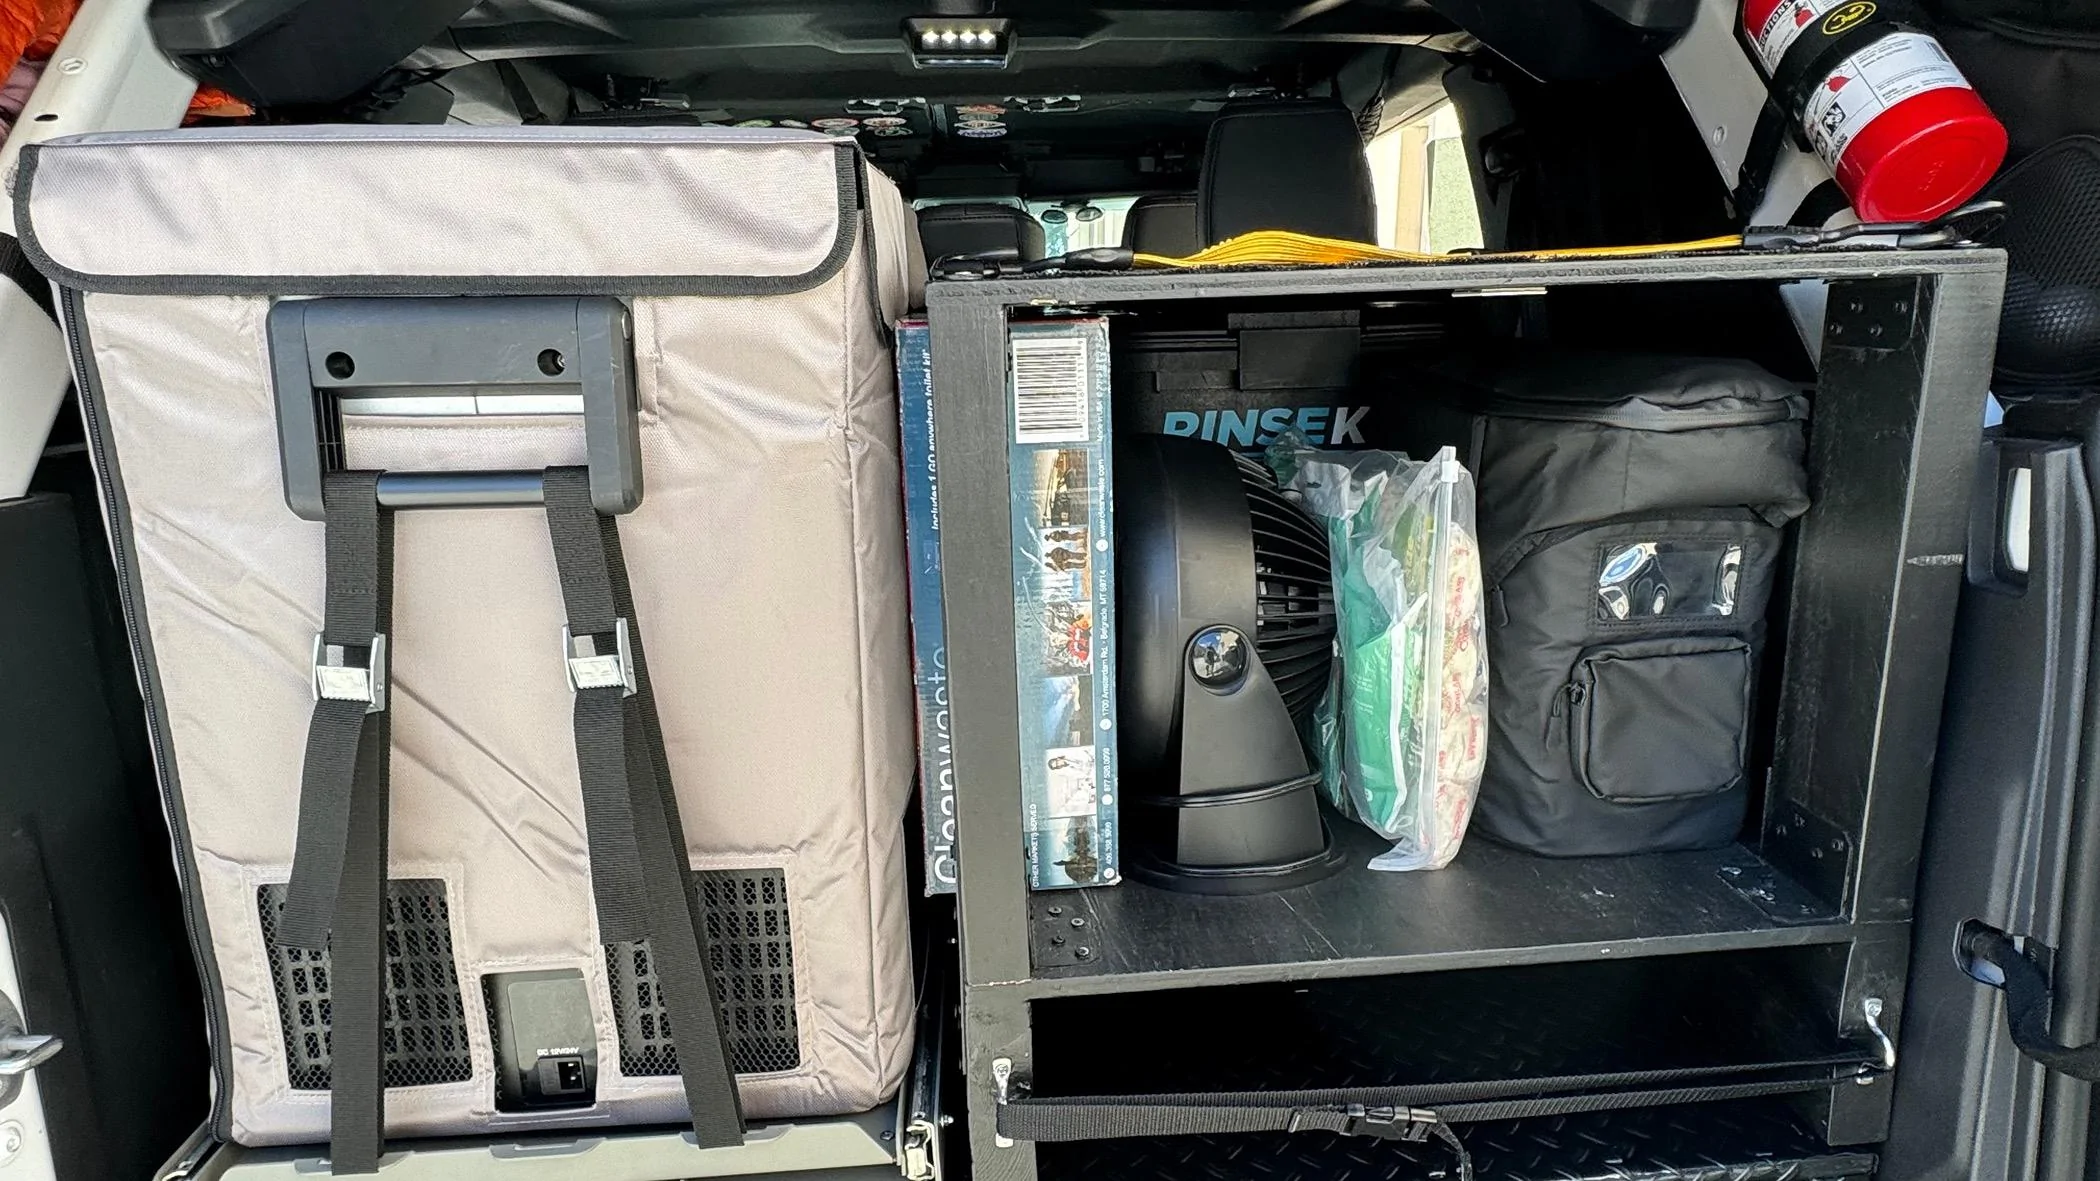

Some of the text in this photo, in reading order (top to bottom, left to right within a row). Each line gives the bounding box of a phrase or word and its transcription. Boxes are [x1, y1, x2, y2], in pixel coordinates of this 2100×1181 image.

[1029, 803, 1040, 888] OTHER MARKETS SERVED
